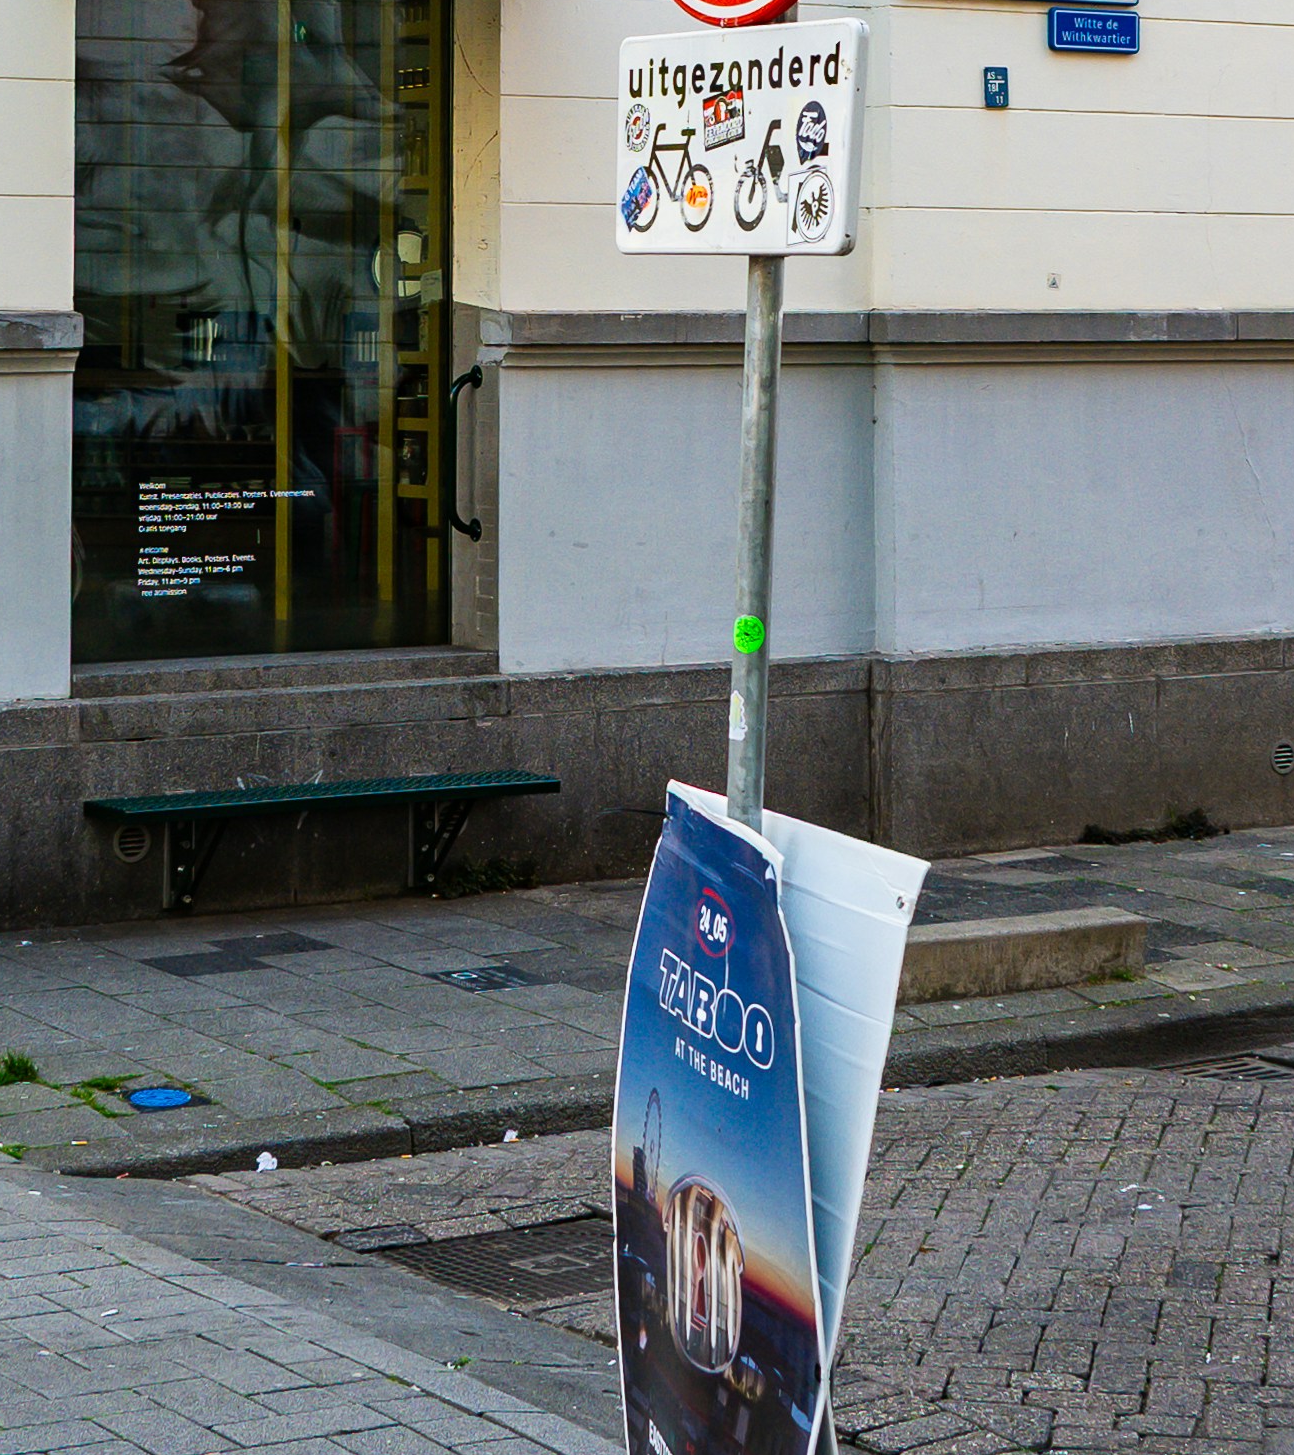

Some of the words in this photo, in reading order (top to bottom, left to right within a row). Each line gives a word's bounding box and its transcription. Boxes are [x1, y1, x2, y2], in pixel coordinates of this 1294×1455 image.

[1074, 16, 1103, 30] Witte
[1106, 18, 1119, 30] de
[1062, 30, 1131, 45] Withkwartier
[629, 41, 841, 109] uitgezonderd
[138, 481, 166, 490] Welkom
[243, 501, 256, 509] uur
[206, 513, 218, 521] uur
[159, 524, 187, 533] toegang
[232, 565, 244, 574] pm
[189, 577, 201, 586] pm
[699, 904, 728, 943] 24_05
[659, 947, 775, 1071] TABOO
[675, 1036, 686, 1061] AT
[688, 1045, 707, 1076] THE
[710, 1059, 750, 1101] BEACH
